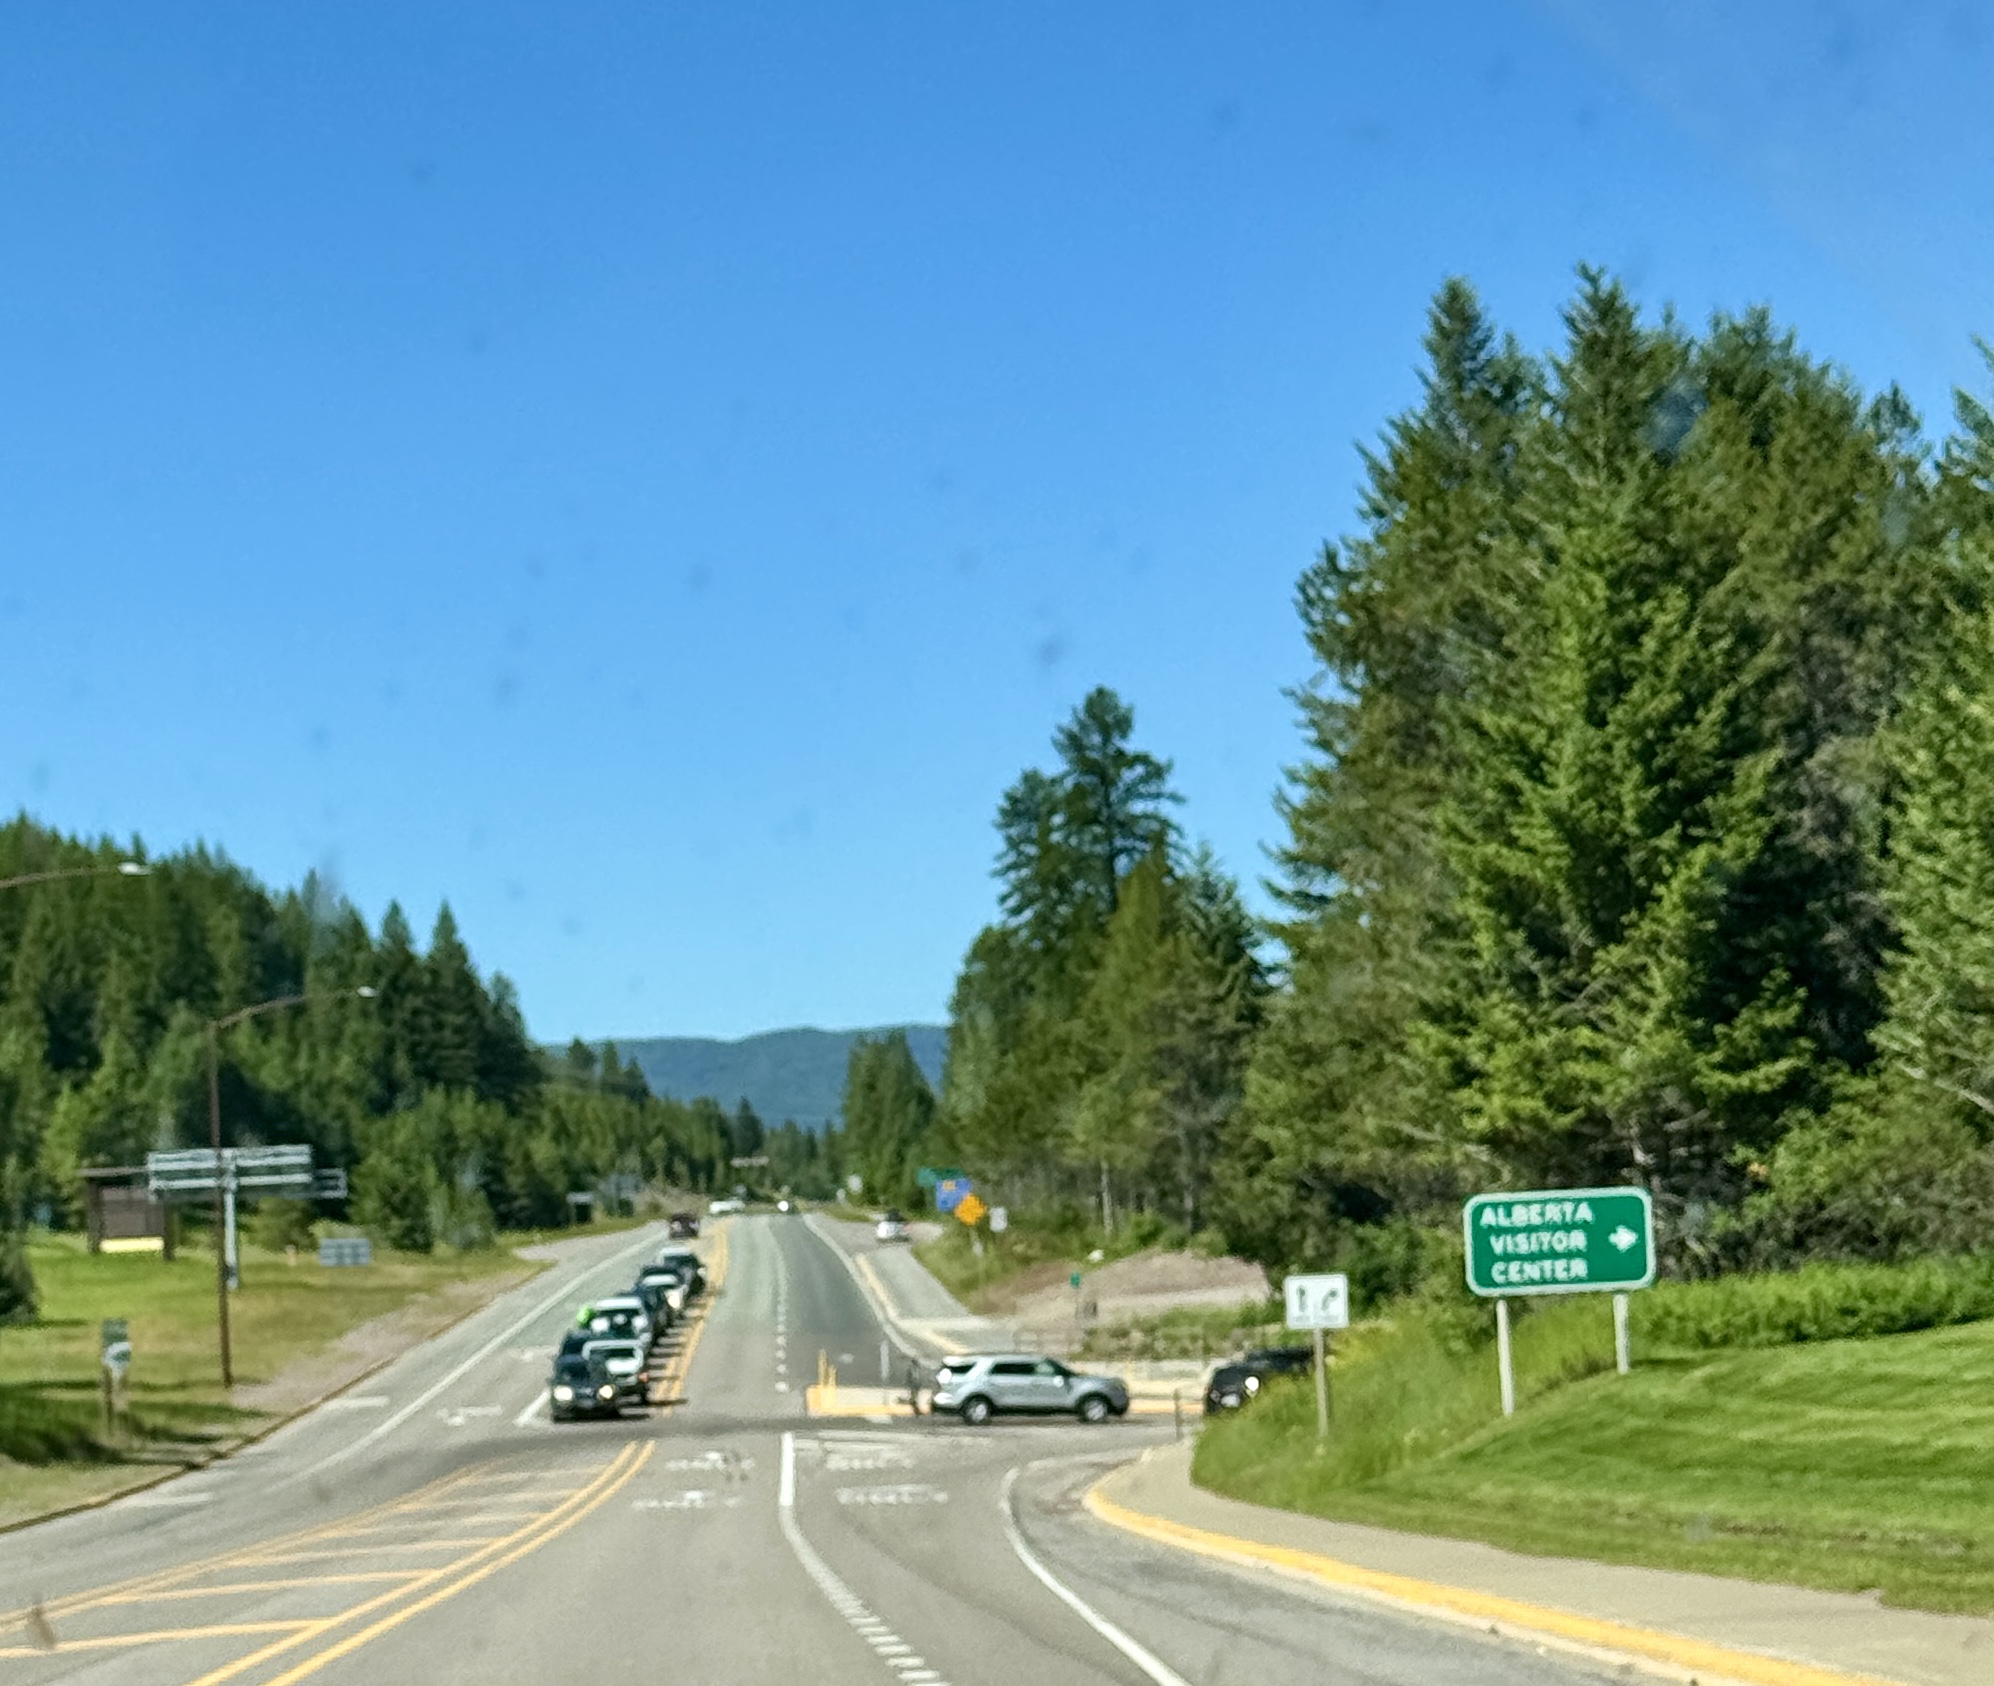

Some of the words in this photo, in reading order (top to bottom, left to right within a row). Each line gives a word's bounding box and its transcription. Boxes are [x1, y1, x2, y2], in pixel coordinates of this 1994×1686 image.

[1481, 1202, 1593, 1227] ALBERTA
[1490, 1230, 1587, 1254] VISITOR
[1491, 1259, 1588, 1283] CENTER
